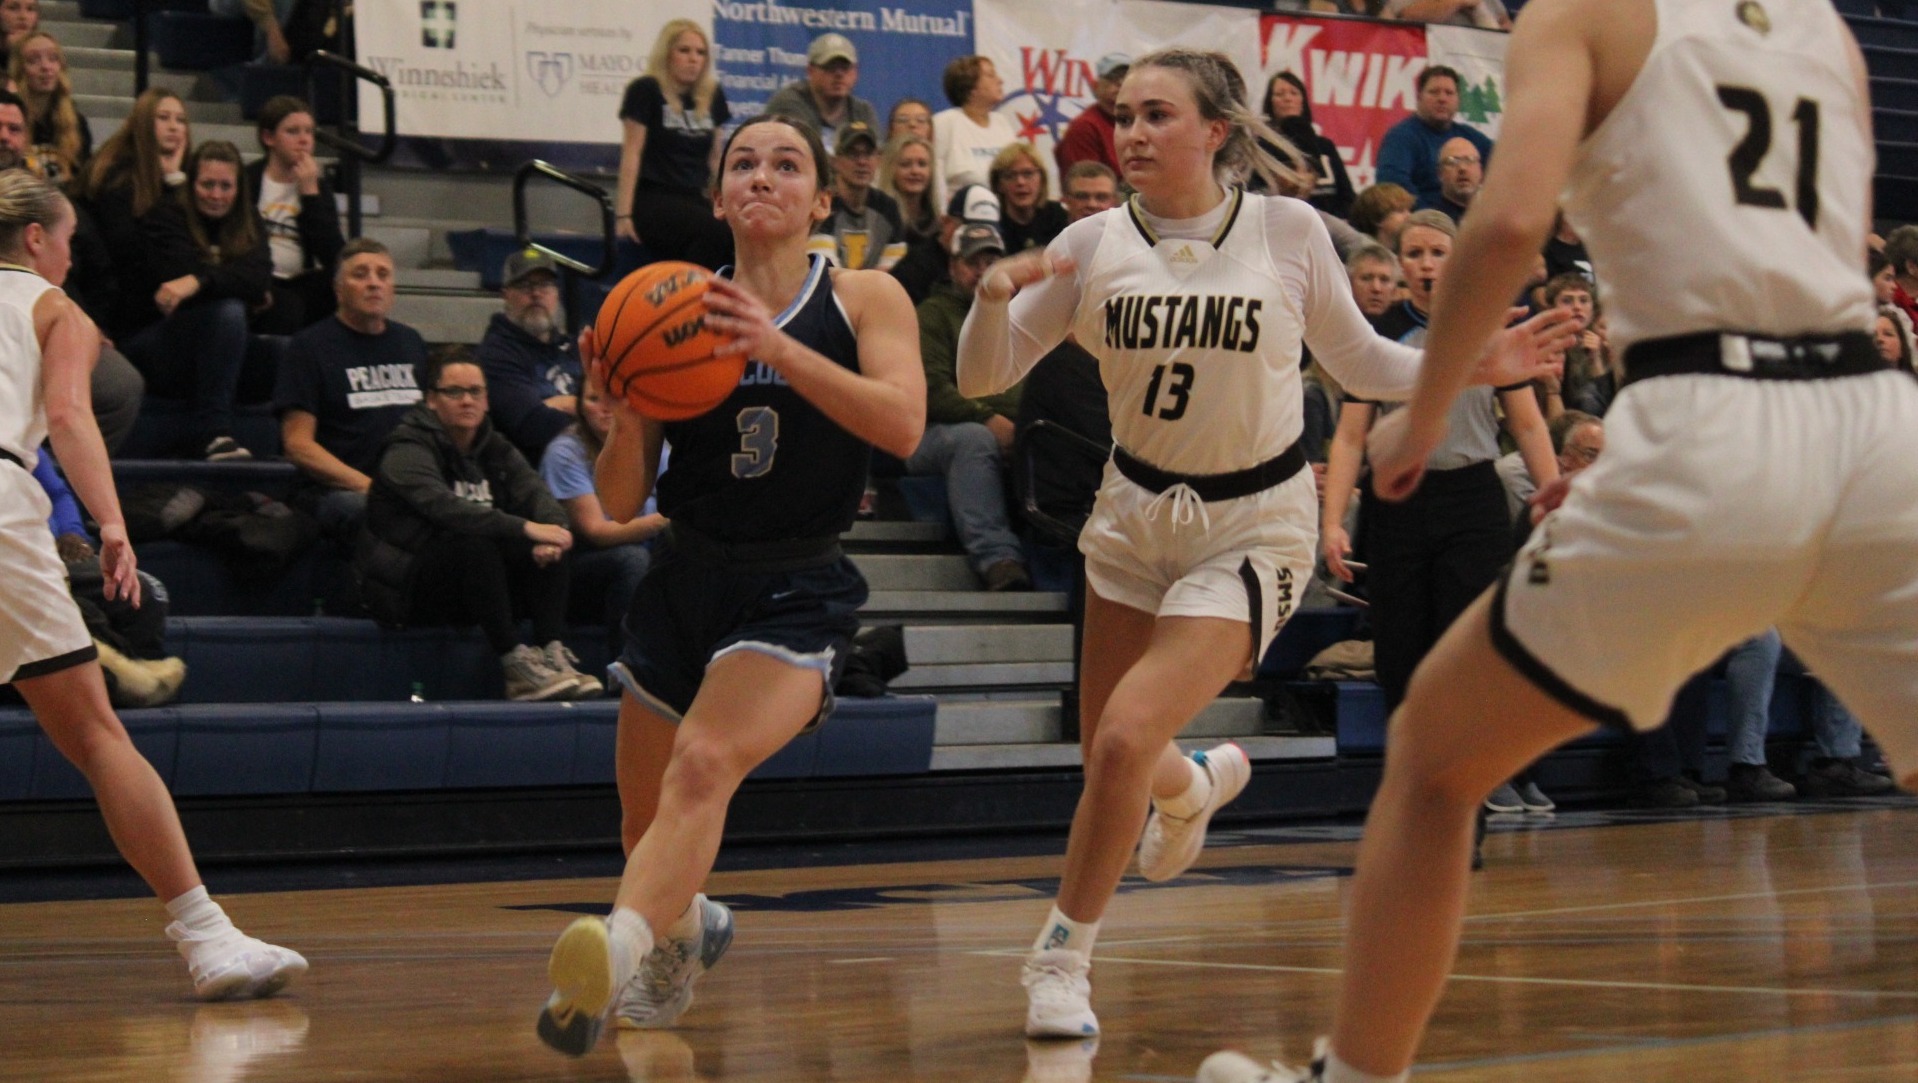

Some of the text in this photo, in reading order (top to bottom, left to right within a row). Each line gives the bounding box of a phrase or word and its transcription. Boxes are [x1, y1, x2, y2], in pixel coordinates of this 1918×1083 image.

[713, 0, 967, 36] Northwestern Mutual
[1262, 23, 1428, 111] KWIK
[1715, 82, 1819, 233] 21
[1105, 294, 1263, 354] MUSTANGS
[1142, 362, 1195, 421] 13
[732, 406, 779, 478] 3
